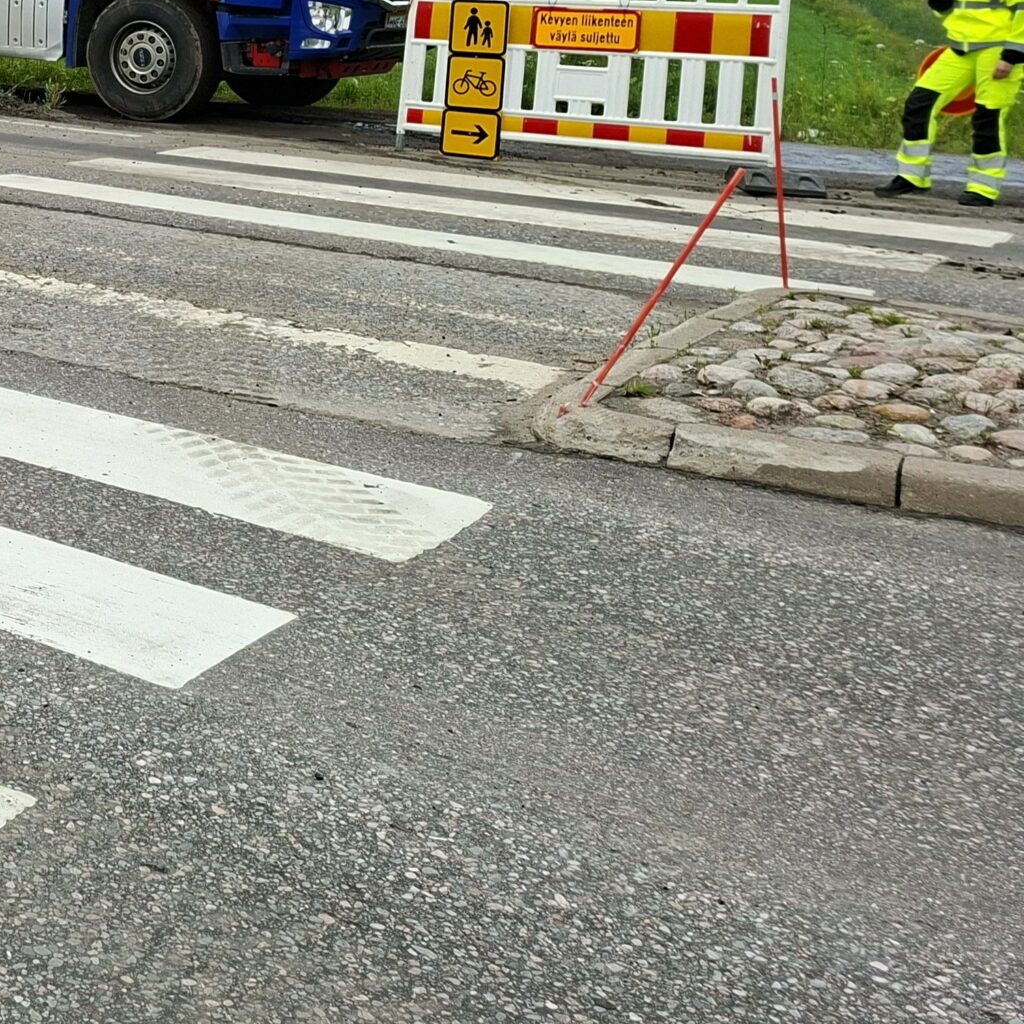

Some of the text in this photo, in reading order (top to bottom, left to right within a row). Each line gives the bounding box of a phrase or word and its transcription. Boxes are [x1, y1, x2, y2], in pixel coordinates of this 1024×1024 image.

[540, 13, 634, 28] Kevyen liikenteen
[549, 29, 620, 45] väylä suljettu
